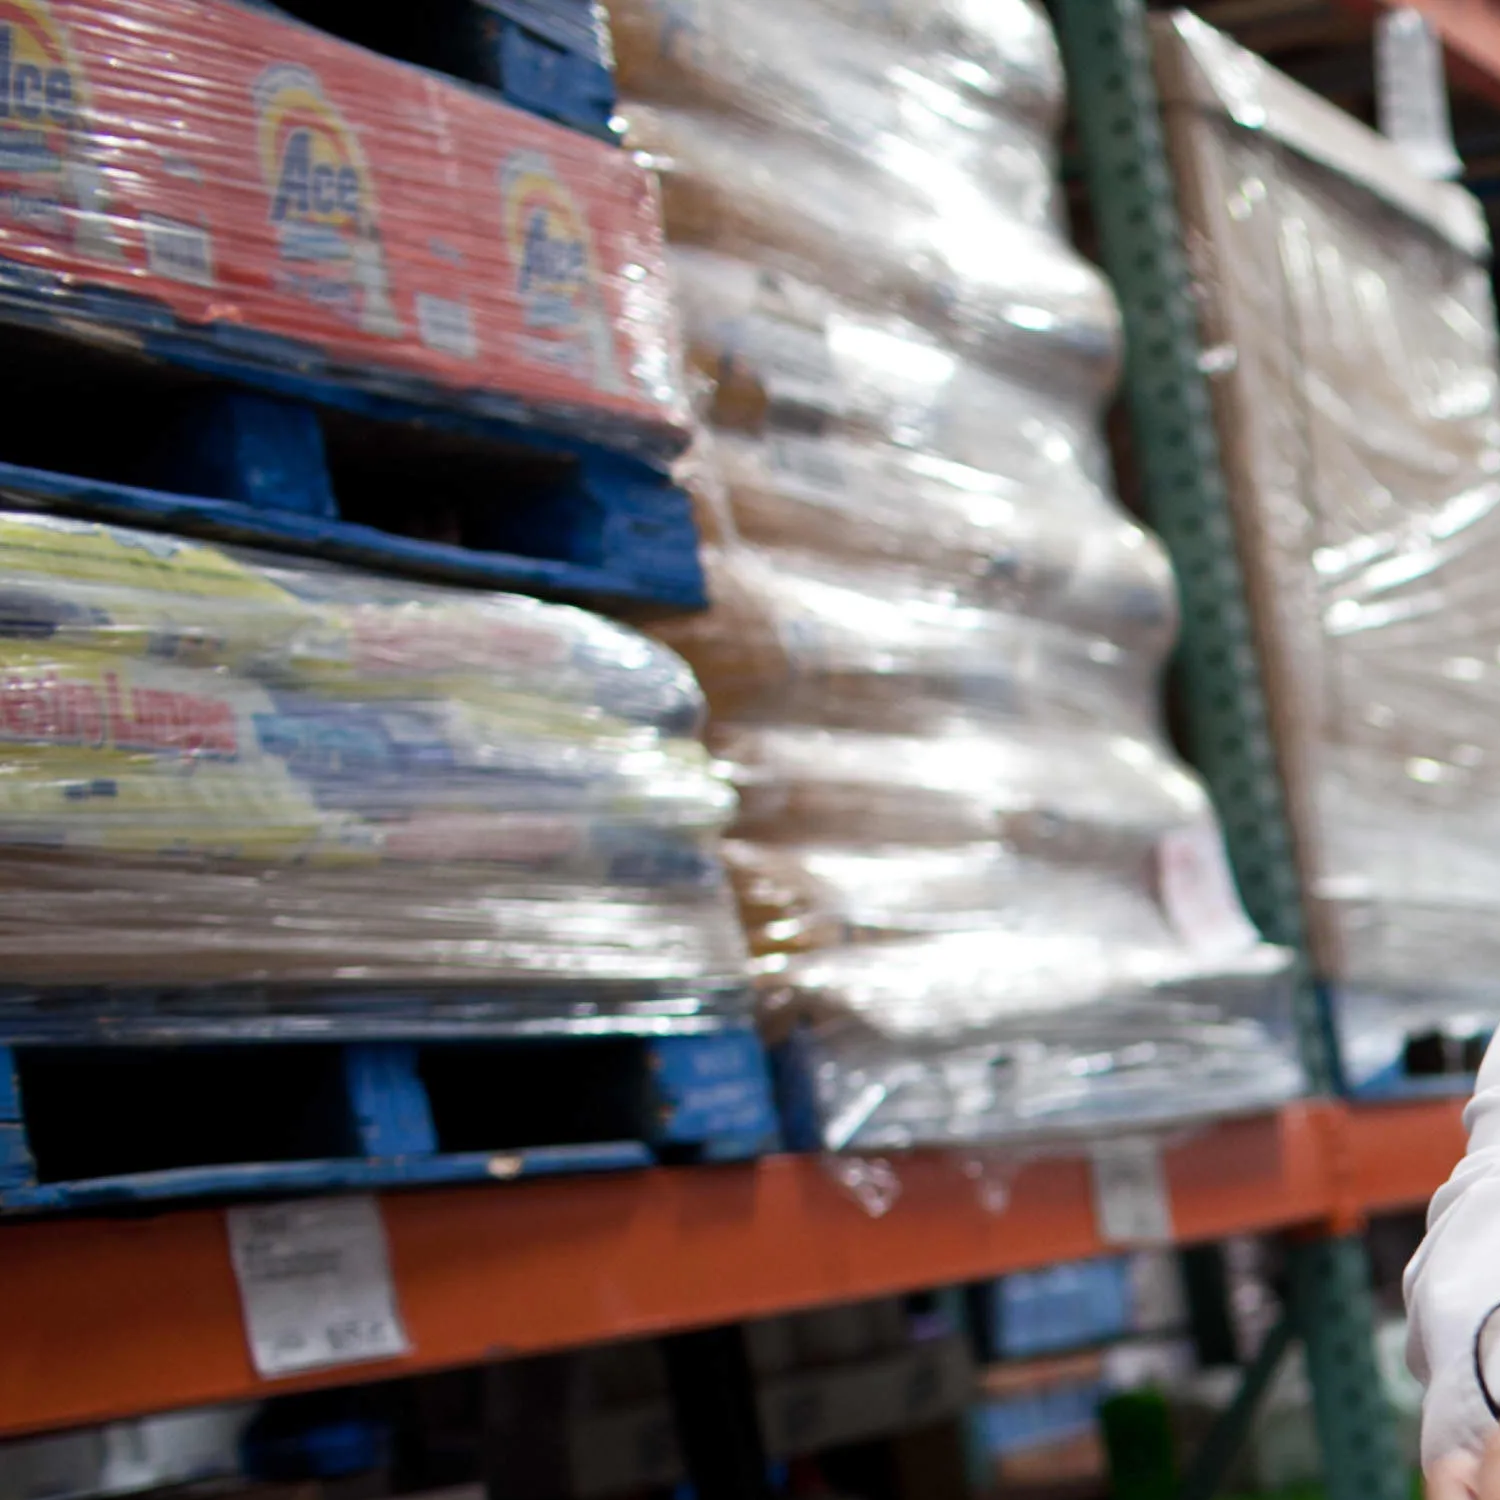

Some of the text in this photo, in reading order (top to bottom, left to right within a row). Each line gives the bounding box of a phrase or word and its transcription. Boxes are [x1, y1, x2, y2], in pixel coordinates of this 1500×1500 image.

[0, 25, 73, 124] ce
[270, 127, 360, 222] Ace
[518, 206, 590, 292] Ace
